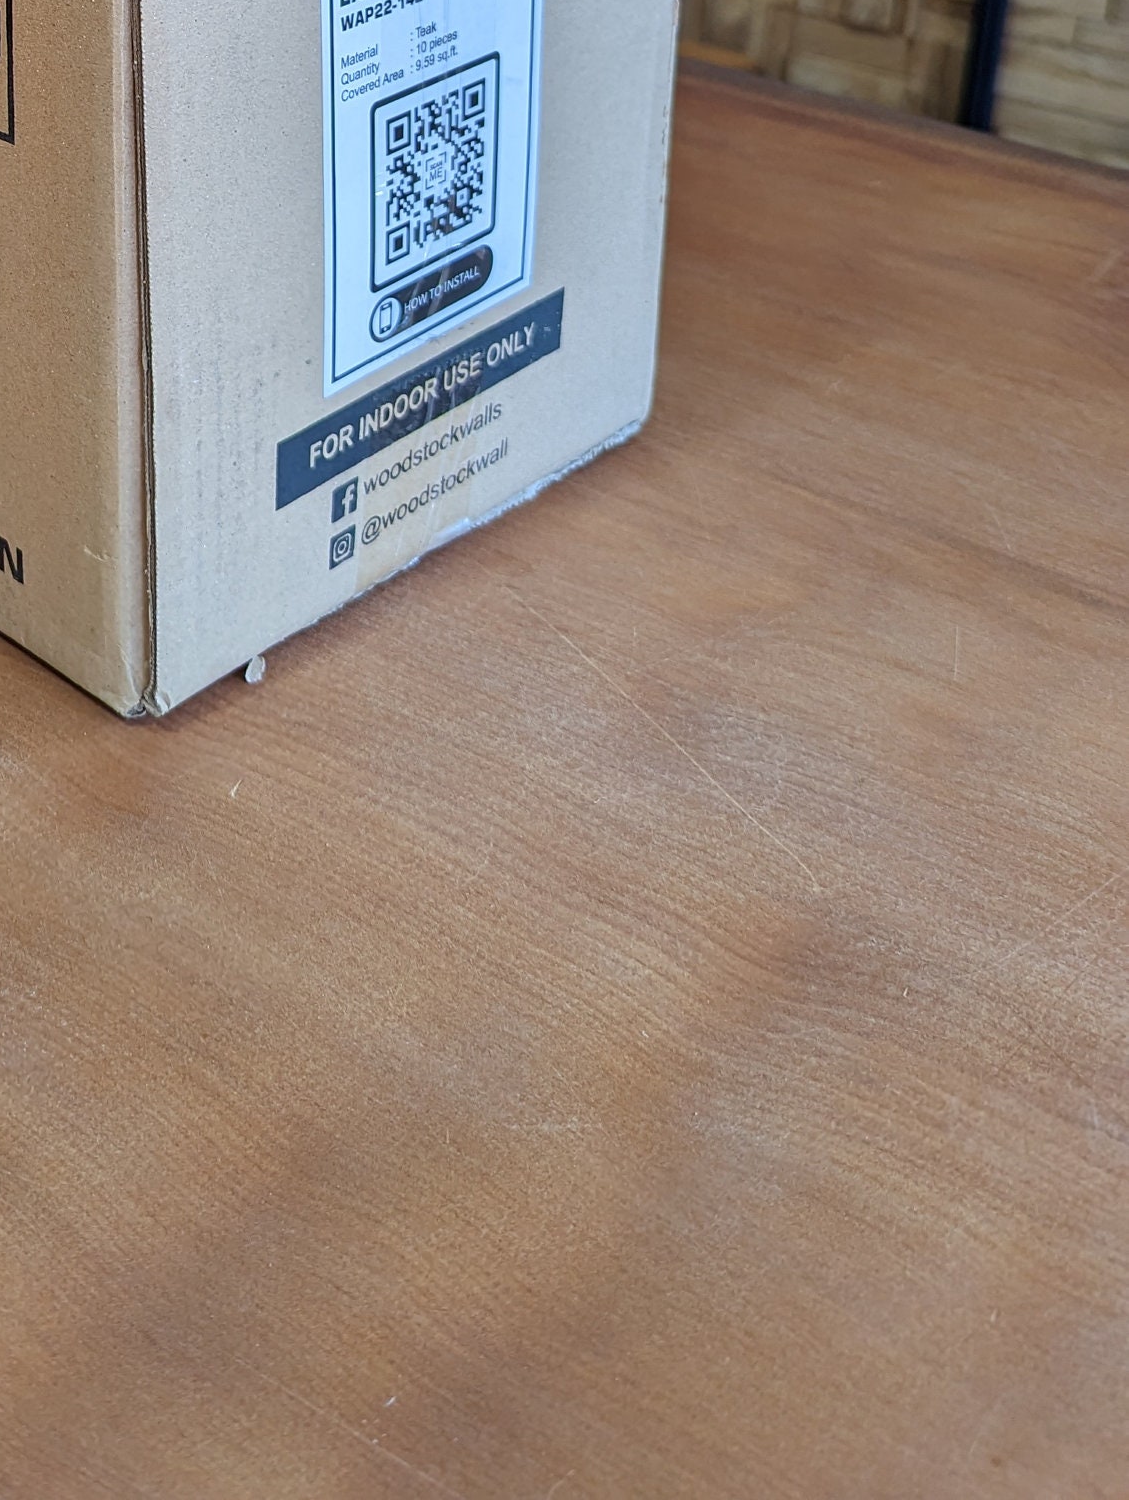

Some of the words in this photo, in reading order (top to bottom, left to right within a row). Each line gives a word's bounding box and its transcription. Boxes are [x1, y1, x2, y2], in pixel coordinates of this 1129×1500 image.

[340, 44, 378, 69] Material
[415, 21, 436, 39] Teak
[340, 62, 380, 85] Quantity
[416, 41, 427, 55] 10
[430, 30, 458, 50] pieces
[340, 76, 381, 102] Covered
[382, 68, 404, 85] Area
[415, 53, 435, 71] 9.59
[429, 168, 443, 182] ME
[404, 292, 428, 314] HOW
[430, 285, 442, 299] TO
[443, 265, 480, 293] INSTALL
[309, 424, 353, 468] FOR
[357, 377, 438, 441] INDOOR
[443, 353, 482, 392] USE
[486, 322, 536, 367] ONLY
[363, 402, 502, 495] woodstockwalls
[361, 437, 509, 545] @woodstockwall
